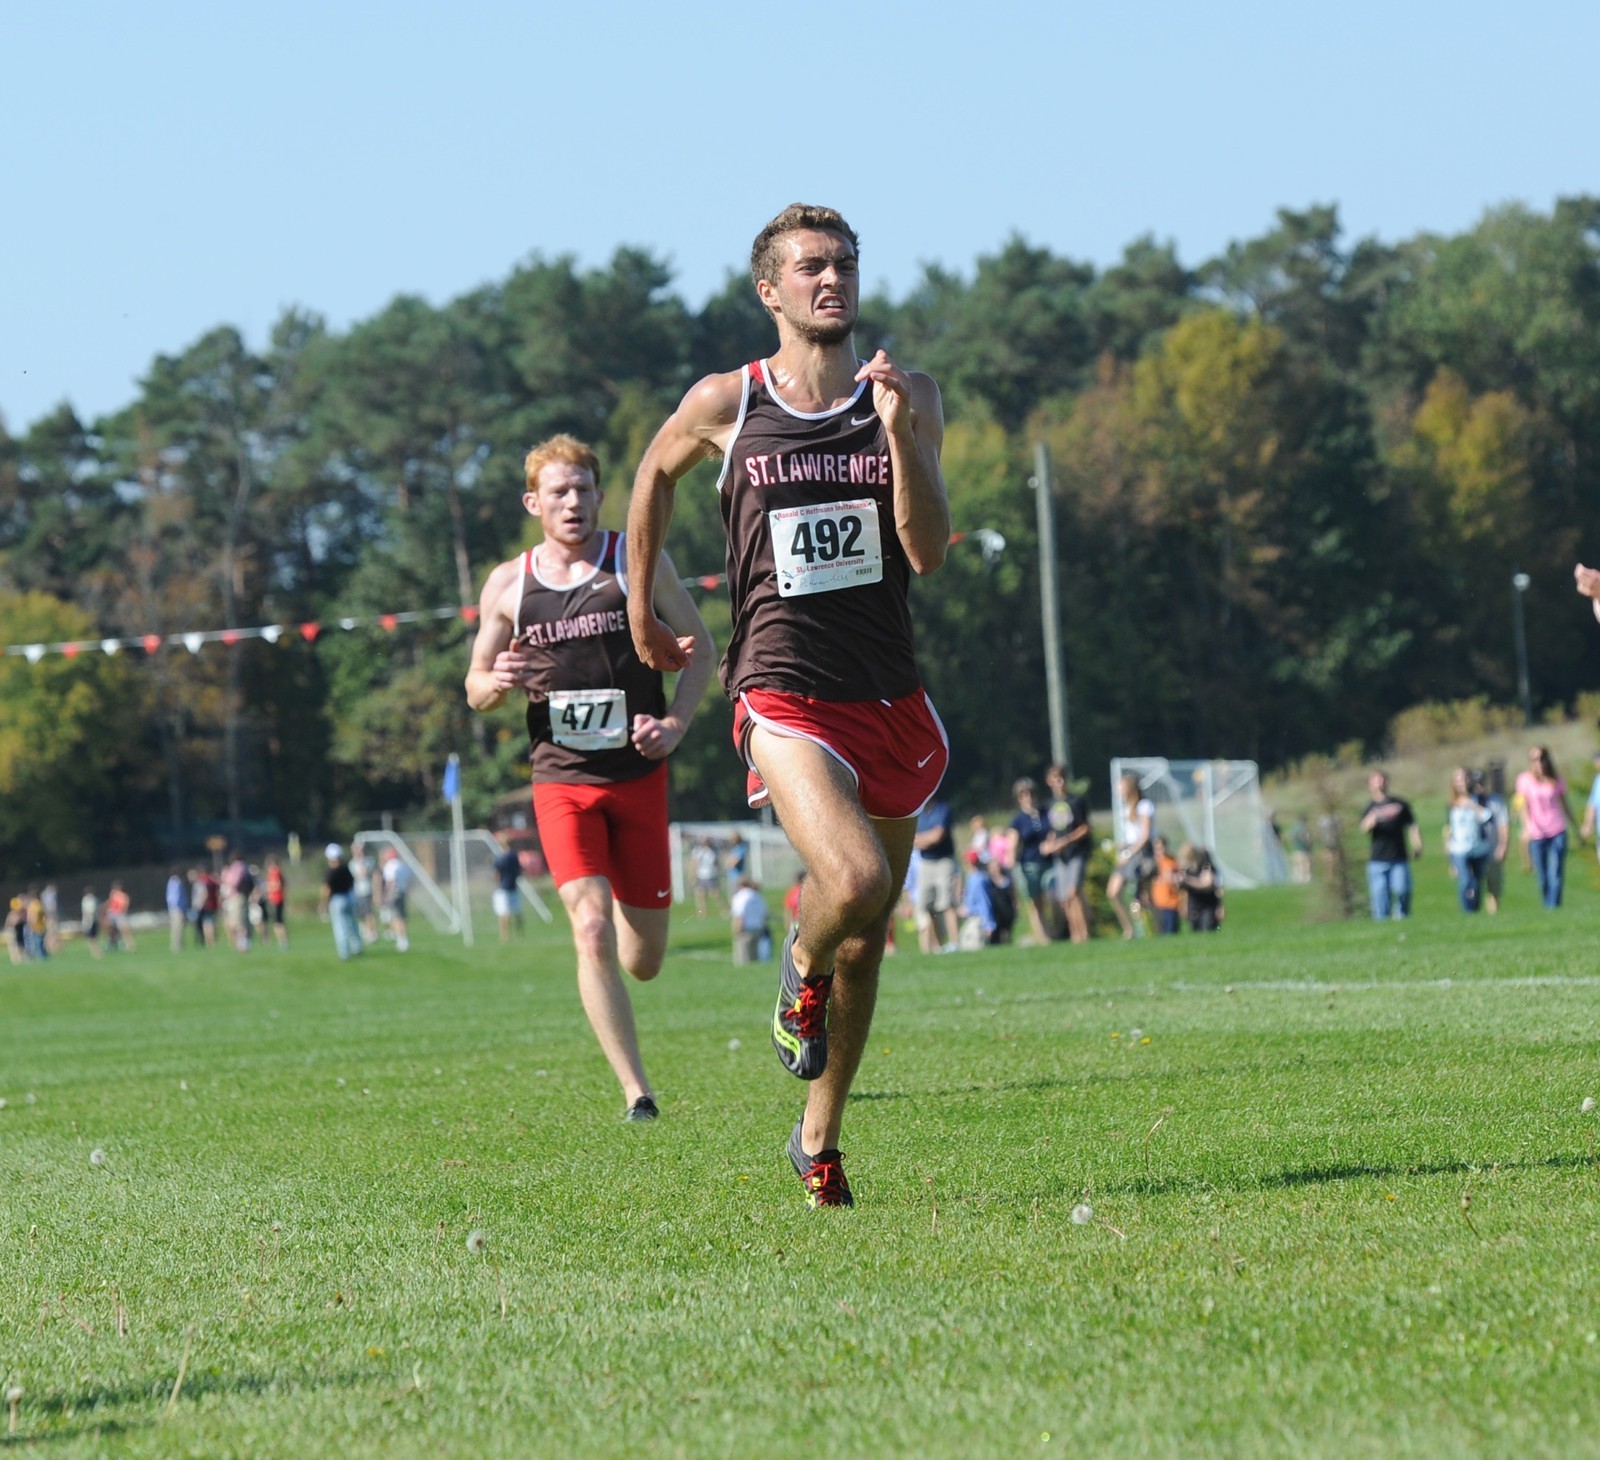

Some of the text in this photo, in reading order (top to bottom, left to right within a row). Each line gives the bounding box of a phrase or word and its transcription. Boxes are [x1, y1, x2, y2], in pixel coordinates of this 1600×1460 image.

[790, 515, 865, 564] 492
[806, 562, 834, 572] Lawrence
[835, 558, 864, 568] University
[561, 701, 614, 731] 477
